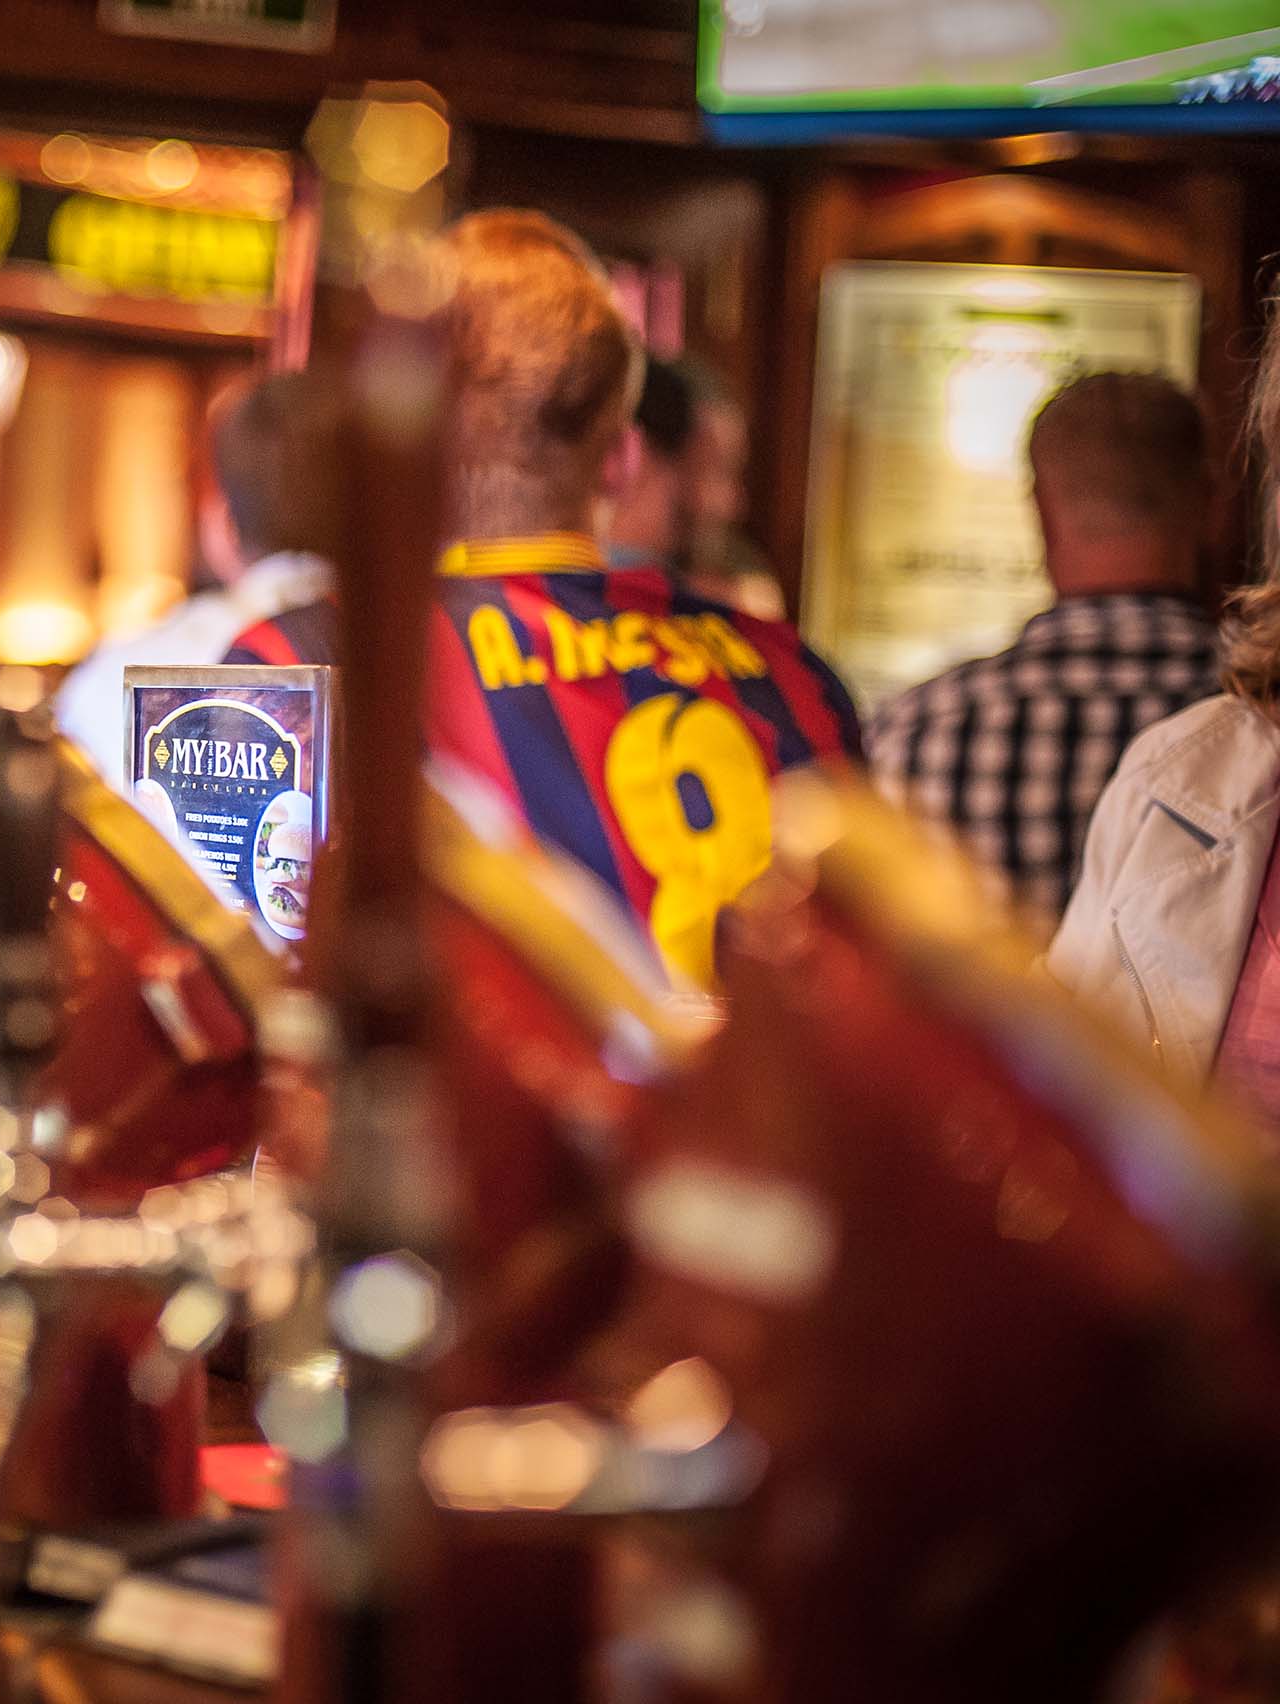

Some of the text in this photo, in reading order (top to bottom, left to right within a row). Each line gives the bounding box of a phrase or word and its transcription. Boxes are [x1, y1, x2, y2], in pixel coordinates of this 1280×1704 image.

[171, 738, 270, 780] MY BAR
[185, 813, 202, 822] FRIED
[203, 814, 232, 825] POTATOES
[189, 831, 208, 840] ONION
[208, 833, 227, 843] RINGS
